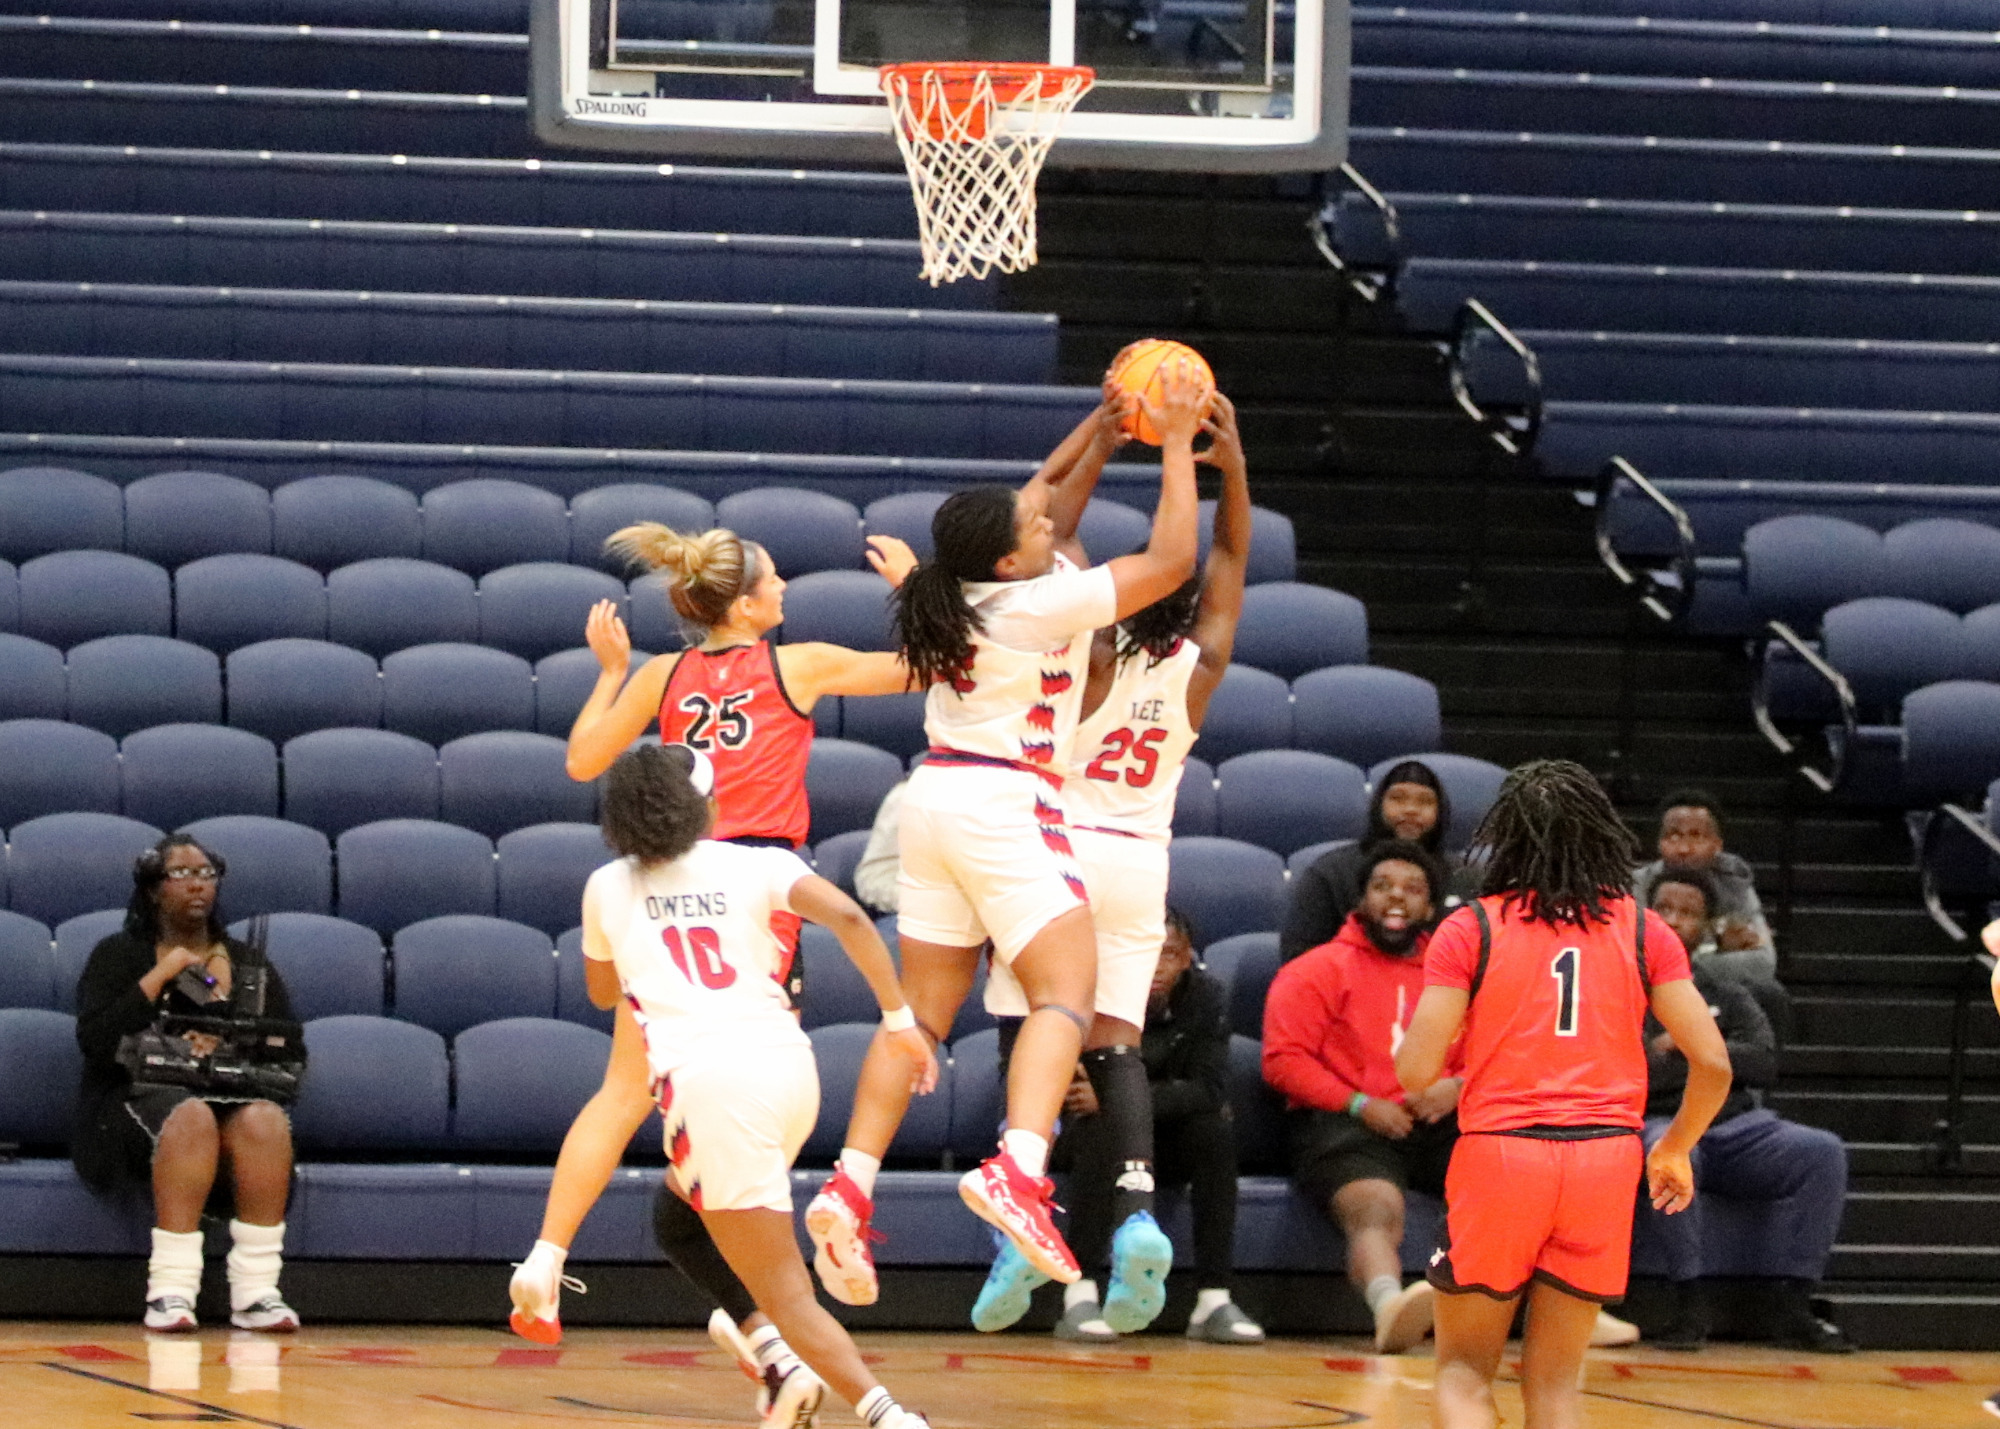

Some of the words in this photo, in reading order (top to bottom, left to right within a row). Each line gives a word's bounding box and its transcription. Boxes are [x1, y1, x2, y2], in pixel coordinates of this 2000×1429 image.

[575, 98, 646, 117] SPALDING
[679, 688, 754, 752] 25
[1131, 699, 1164, 721] LEE
[1085, 727, 1168, 788] 25
[645, 892, 727, 920] OWENS
[662, 925, 737, 990] 10
[1550, 946, 1580, 1036] 1
